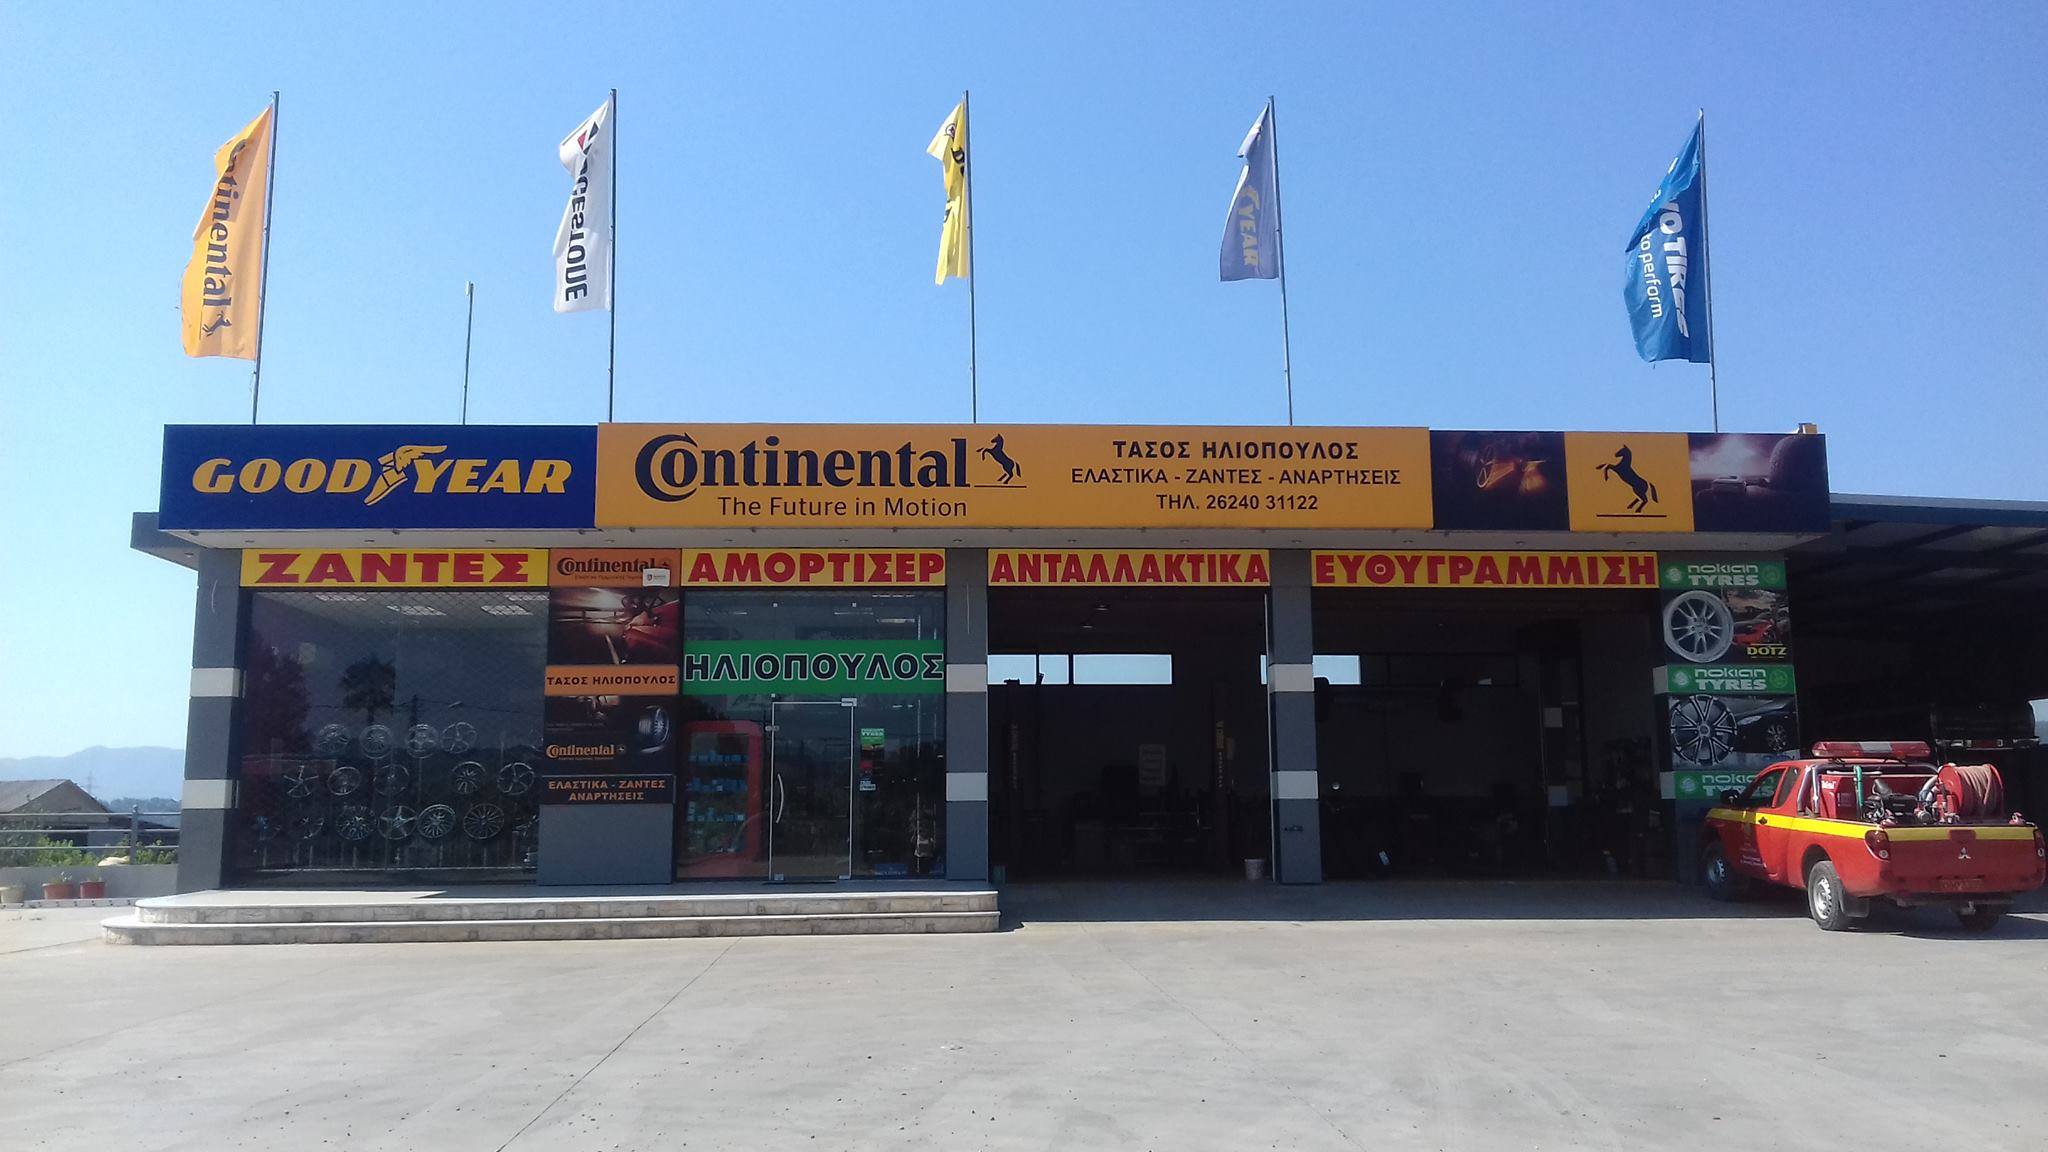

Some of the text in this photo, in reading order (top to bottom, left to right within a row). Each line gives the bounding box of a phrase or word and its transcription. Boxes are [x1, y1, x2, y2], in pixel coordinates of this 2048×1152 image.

[1637, 252, 1664, 318] perform
[1112, 440, 1359, 460] ΤΑΣΟΣ ΗΛΙΟΠΟΥΛΟΣ
[635, 432, 971, 502] Continental
[1071, 468, 1168, 484] ΕΛΑΣΤΙΚΑ
[1185, 469, 1262, 484] ΖΑΝΤΕΣ
[1279, 469, 1401, 485] ΑΝΑΡΤΗΣΕΙΣ
[718, 497, 967, 517] The Future in Motion
[1156, 494, 1318, 510] ΤΗΛ. 26240 31122
[255, 553, 529, 583] ΖΑΝΤΕΣ
[557, 557, 656, 575] Continental
[688, 552, 945, 583] ΑΜΟΡΤΙΣΕΡ
[990, 553, 1269, 583] ΑΝΤΑΛΛΑΚΤΙΚΑ
[1316, 554, 1656, 585] ΕΥΘΥΓΡΑΜΜΙΣΗ
[1688, 574, 1759, 586] TYRES
[1747, 646, 1787, 656] DOTZ
[684, 652, 945, 681] ΗΛΙΟΠΟΥΛΟΣ
[546, 675, 676, 686] ΤΑΣΟΣ ΗΛΙΟΠΟΥΛΟΣ
[1695, 678, 1768, 691] TYRES
[546, 744, 615, 758] Continental
[549, 780, 608, 790] ΕΛΑΣΤΙΚΑ
[618, 780, 666, 789] ΖΑΝΤΕΣ
[568, 791, 645, 801] ΑΝΑΡΤΗΣΕΙΣ
